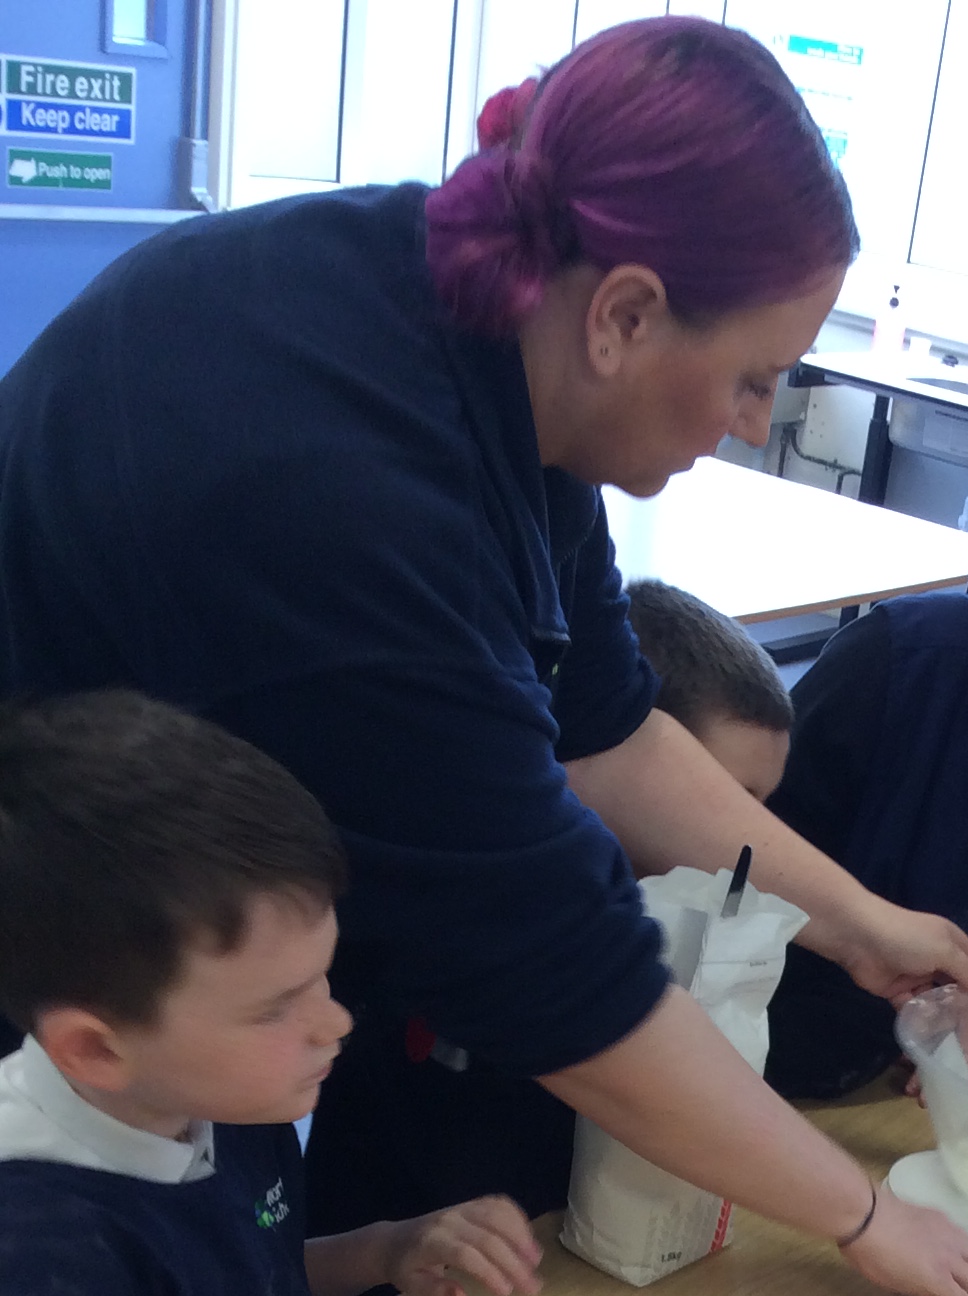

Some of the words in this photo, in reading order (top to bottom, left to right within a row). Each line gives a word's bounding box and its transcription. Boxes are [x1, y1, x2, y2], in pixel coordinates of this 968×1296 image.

[20, 64, 70, 96] Fire
[75, 73, 121, 101] exit
[21, 102, 70, 133] Keep
[74, 107, 120, 132] clear
[38, 162, 68, 178] Push
[70, 163, 81, 179] to
[84, 167, 111, 183] open
